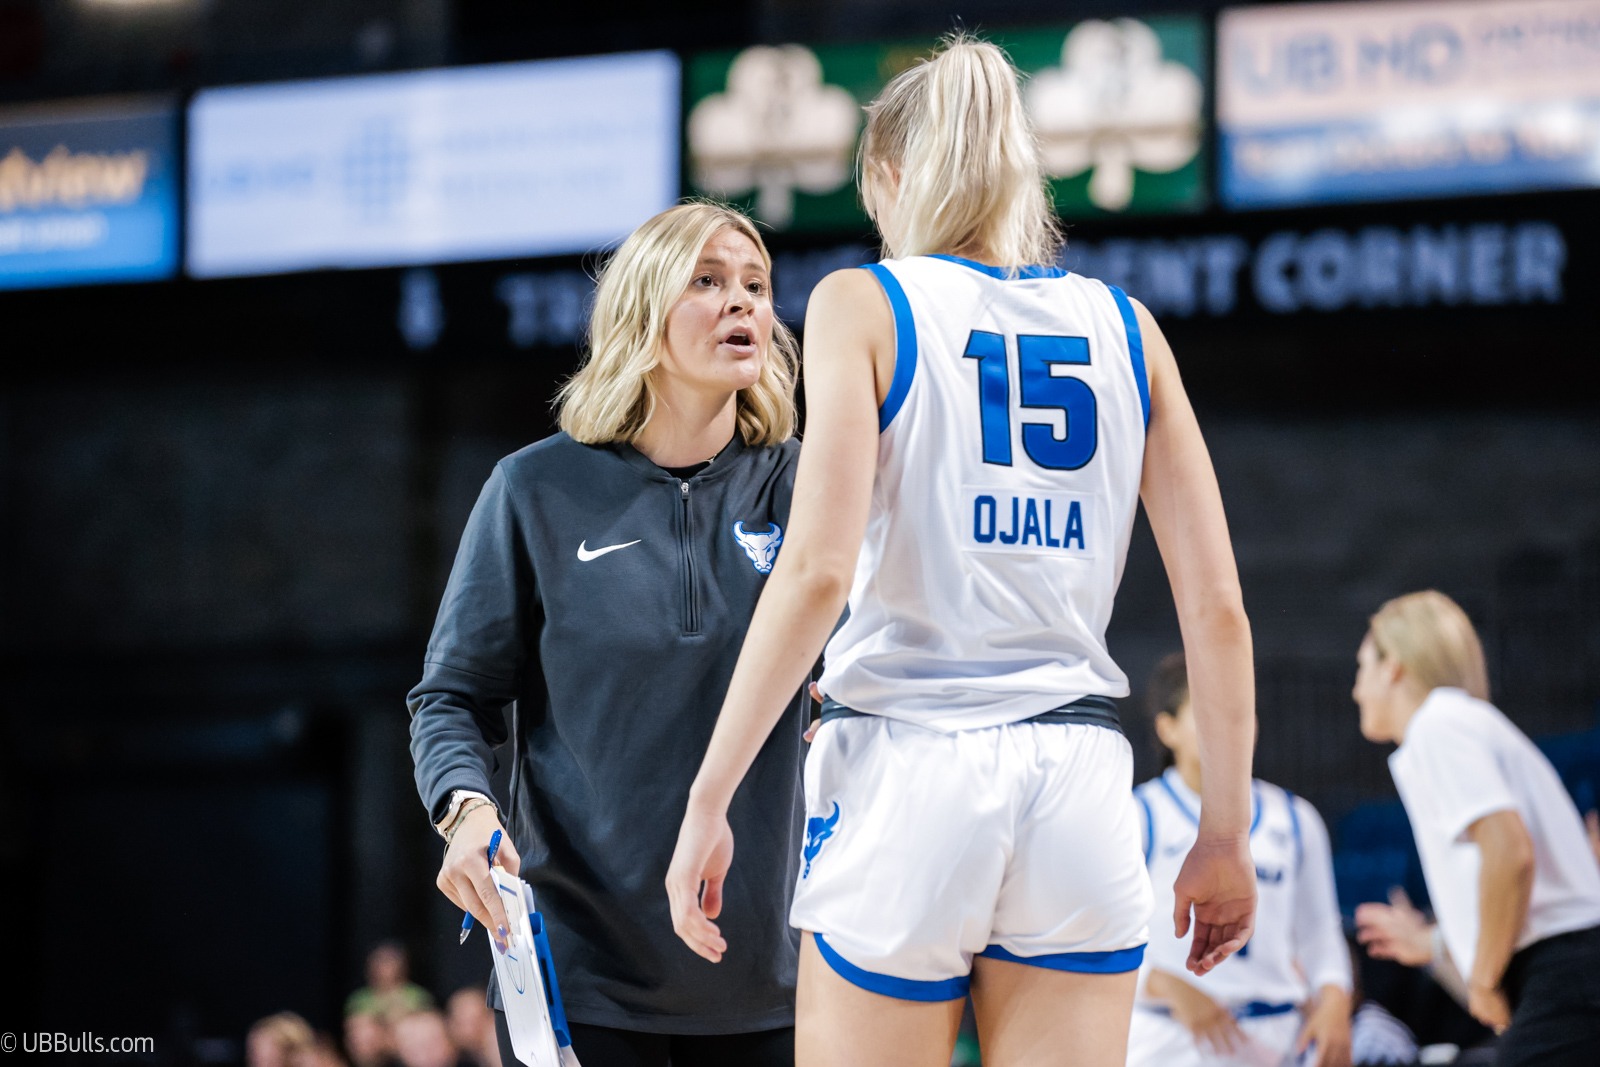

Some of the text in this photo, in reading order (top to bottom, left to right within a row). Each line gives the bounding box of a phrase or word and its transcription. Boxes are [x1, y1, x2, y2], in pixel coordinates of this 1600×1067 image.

[1254, 221, 1567, 312] CORNER
[962, 329, 1098, 471] 15
[973, 495, 1085, 550] OJALA
